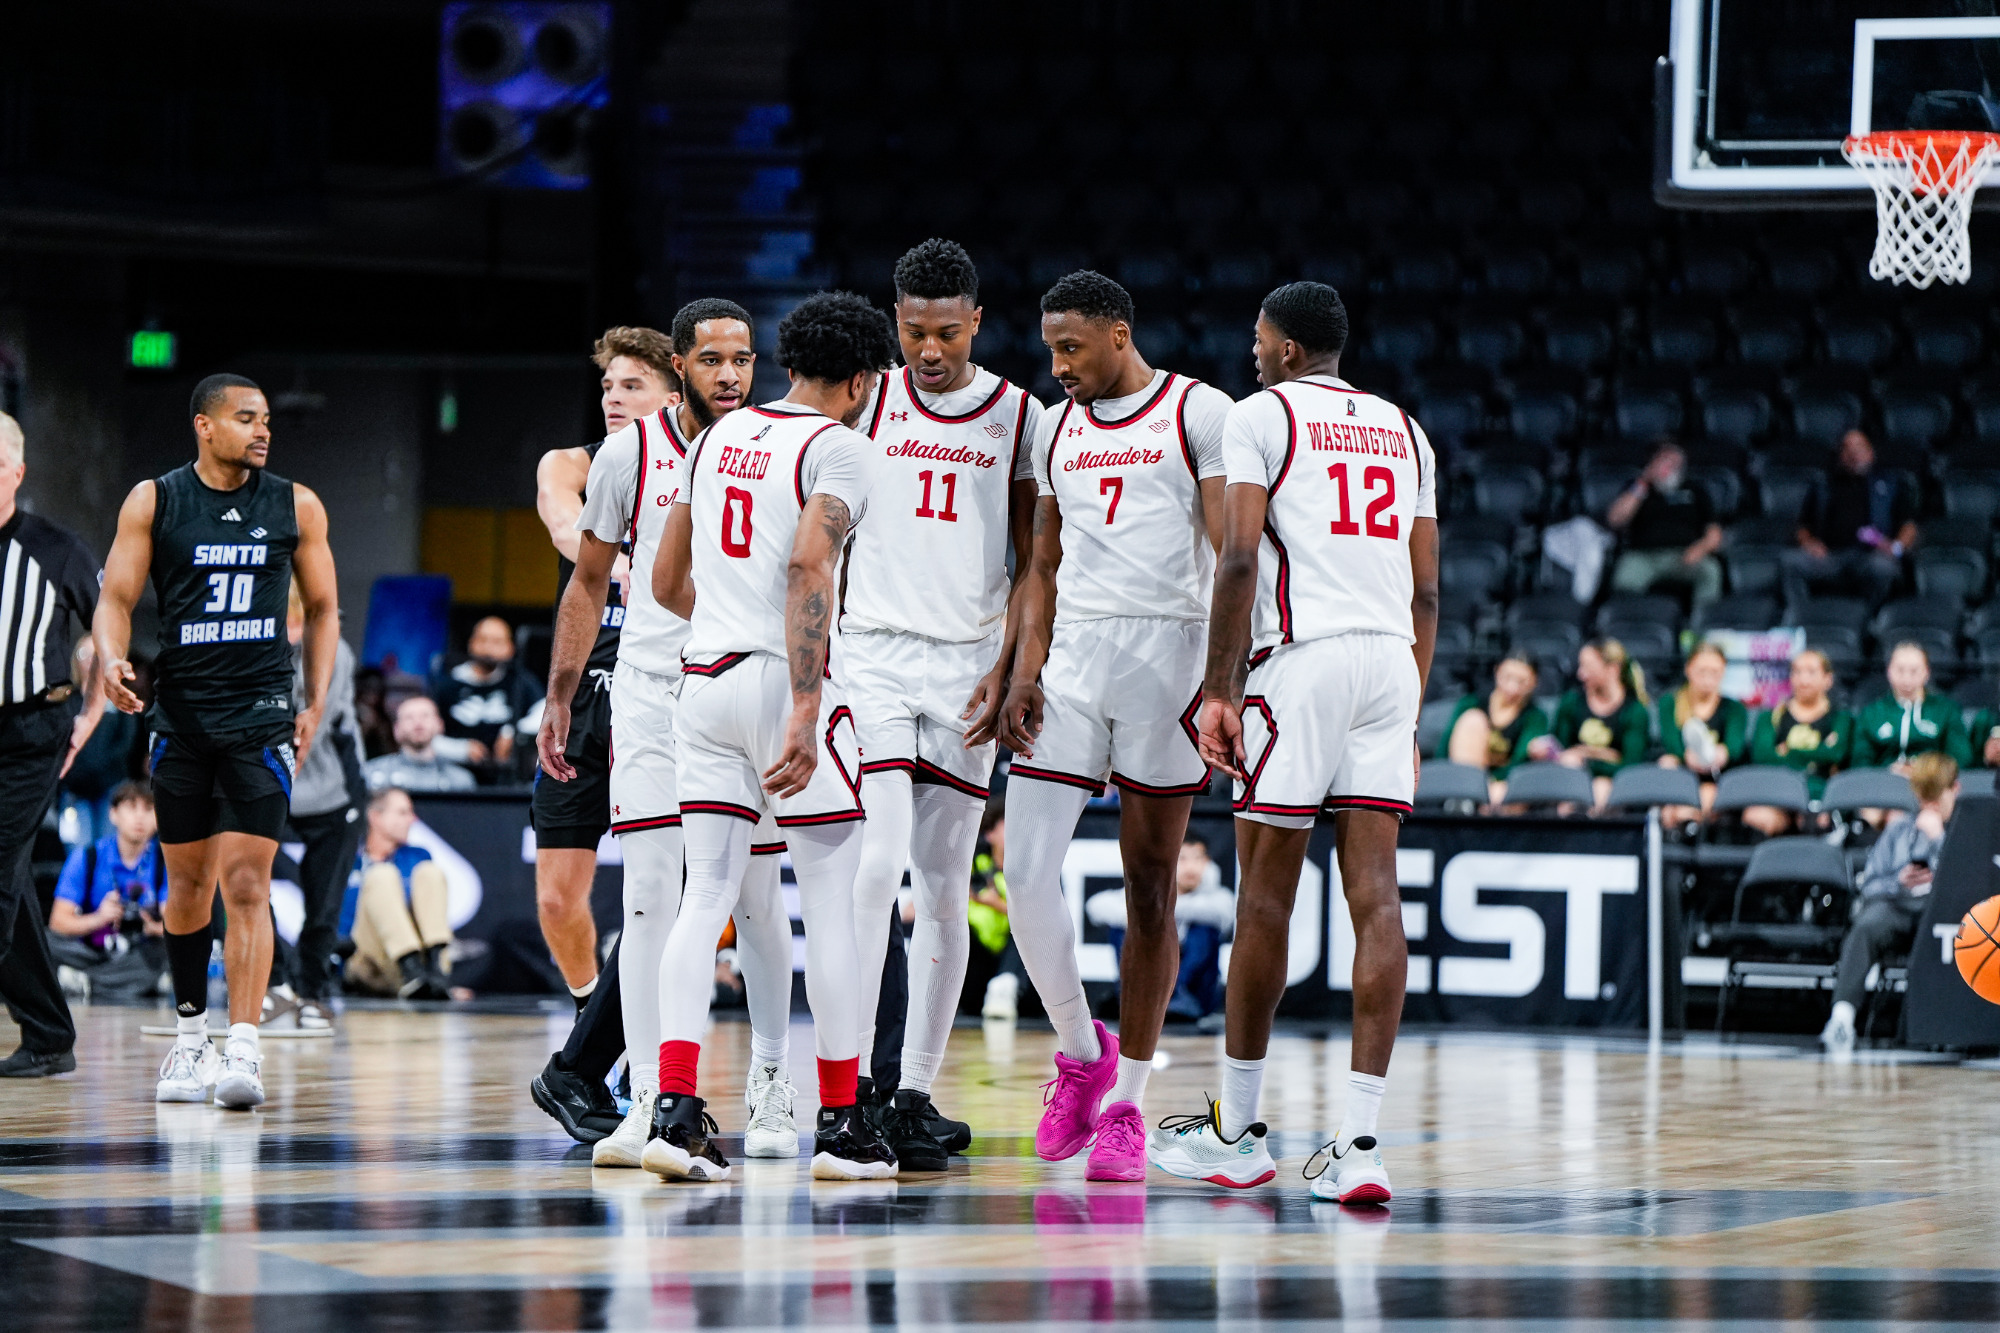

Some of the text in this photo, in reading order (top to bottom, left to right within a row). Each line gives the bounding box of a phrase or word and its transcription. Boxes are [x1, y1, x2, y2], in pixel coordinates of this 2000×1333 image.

[886, 438, 997, 469] Matadors
[1063, 446, 1165, 472] Matadors
[1306, 421, 1408, 460] WASHINGTON
[717, 445, 772, 480] BEARD
[915, 469, 958, 522] 11
[1099, 476, 1124, 526] 7
[1327, 462, 1399, 540] 12
[721, 485, 753, 559] 0
[193, 544, 268, 566] SANTA
[204, 572, 255, 613] 30
[180, 617, 276, 645] BARBARA
